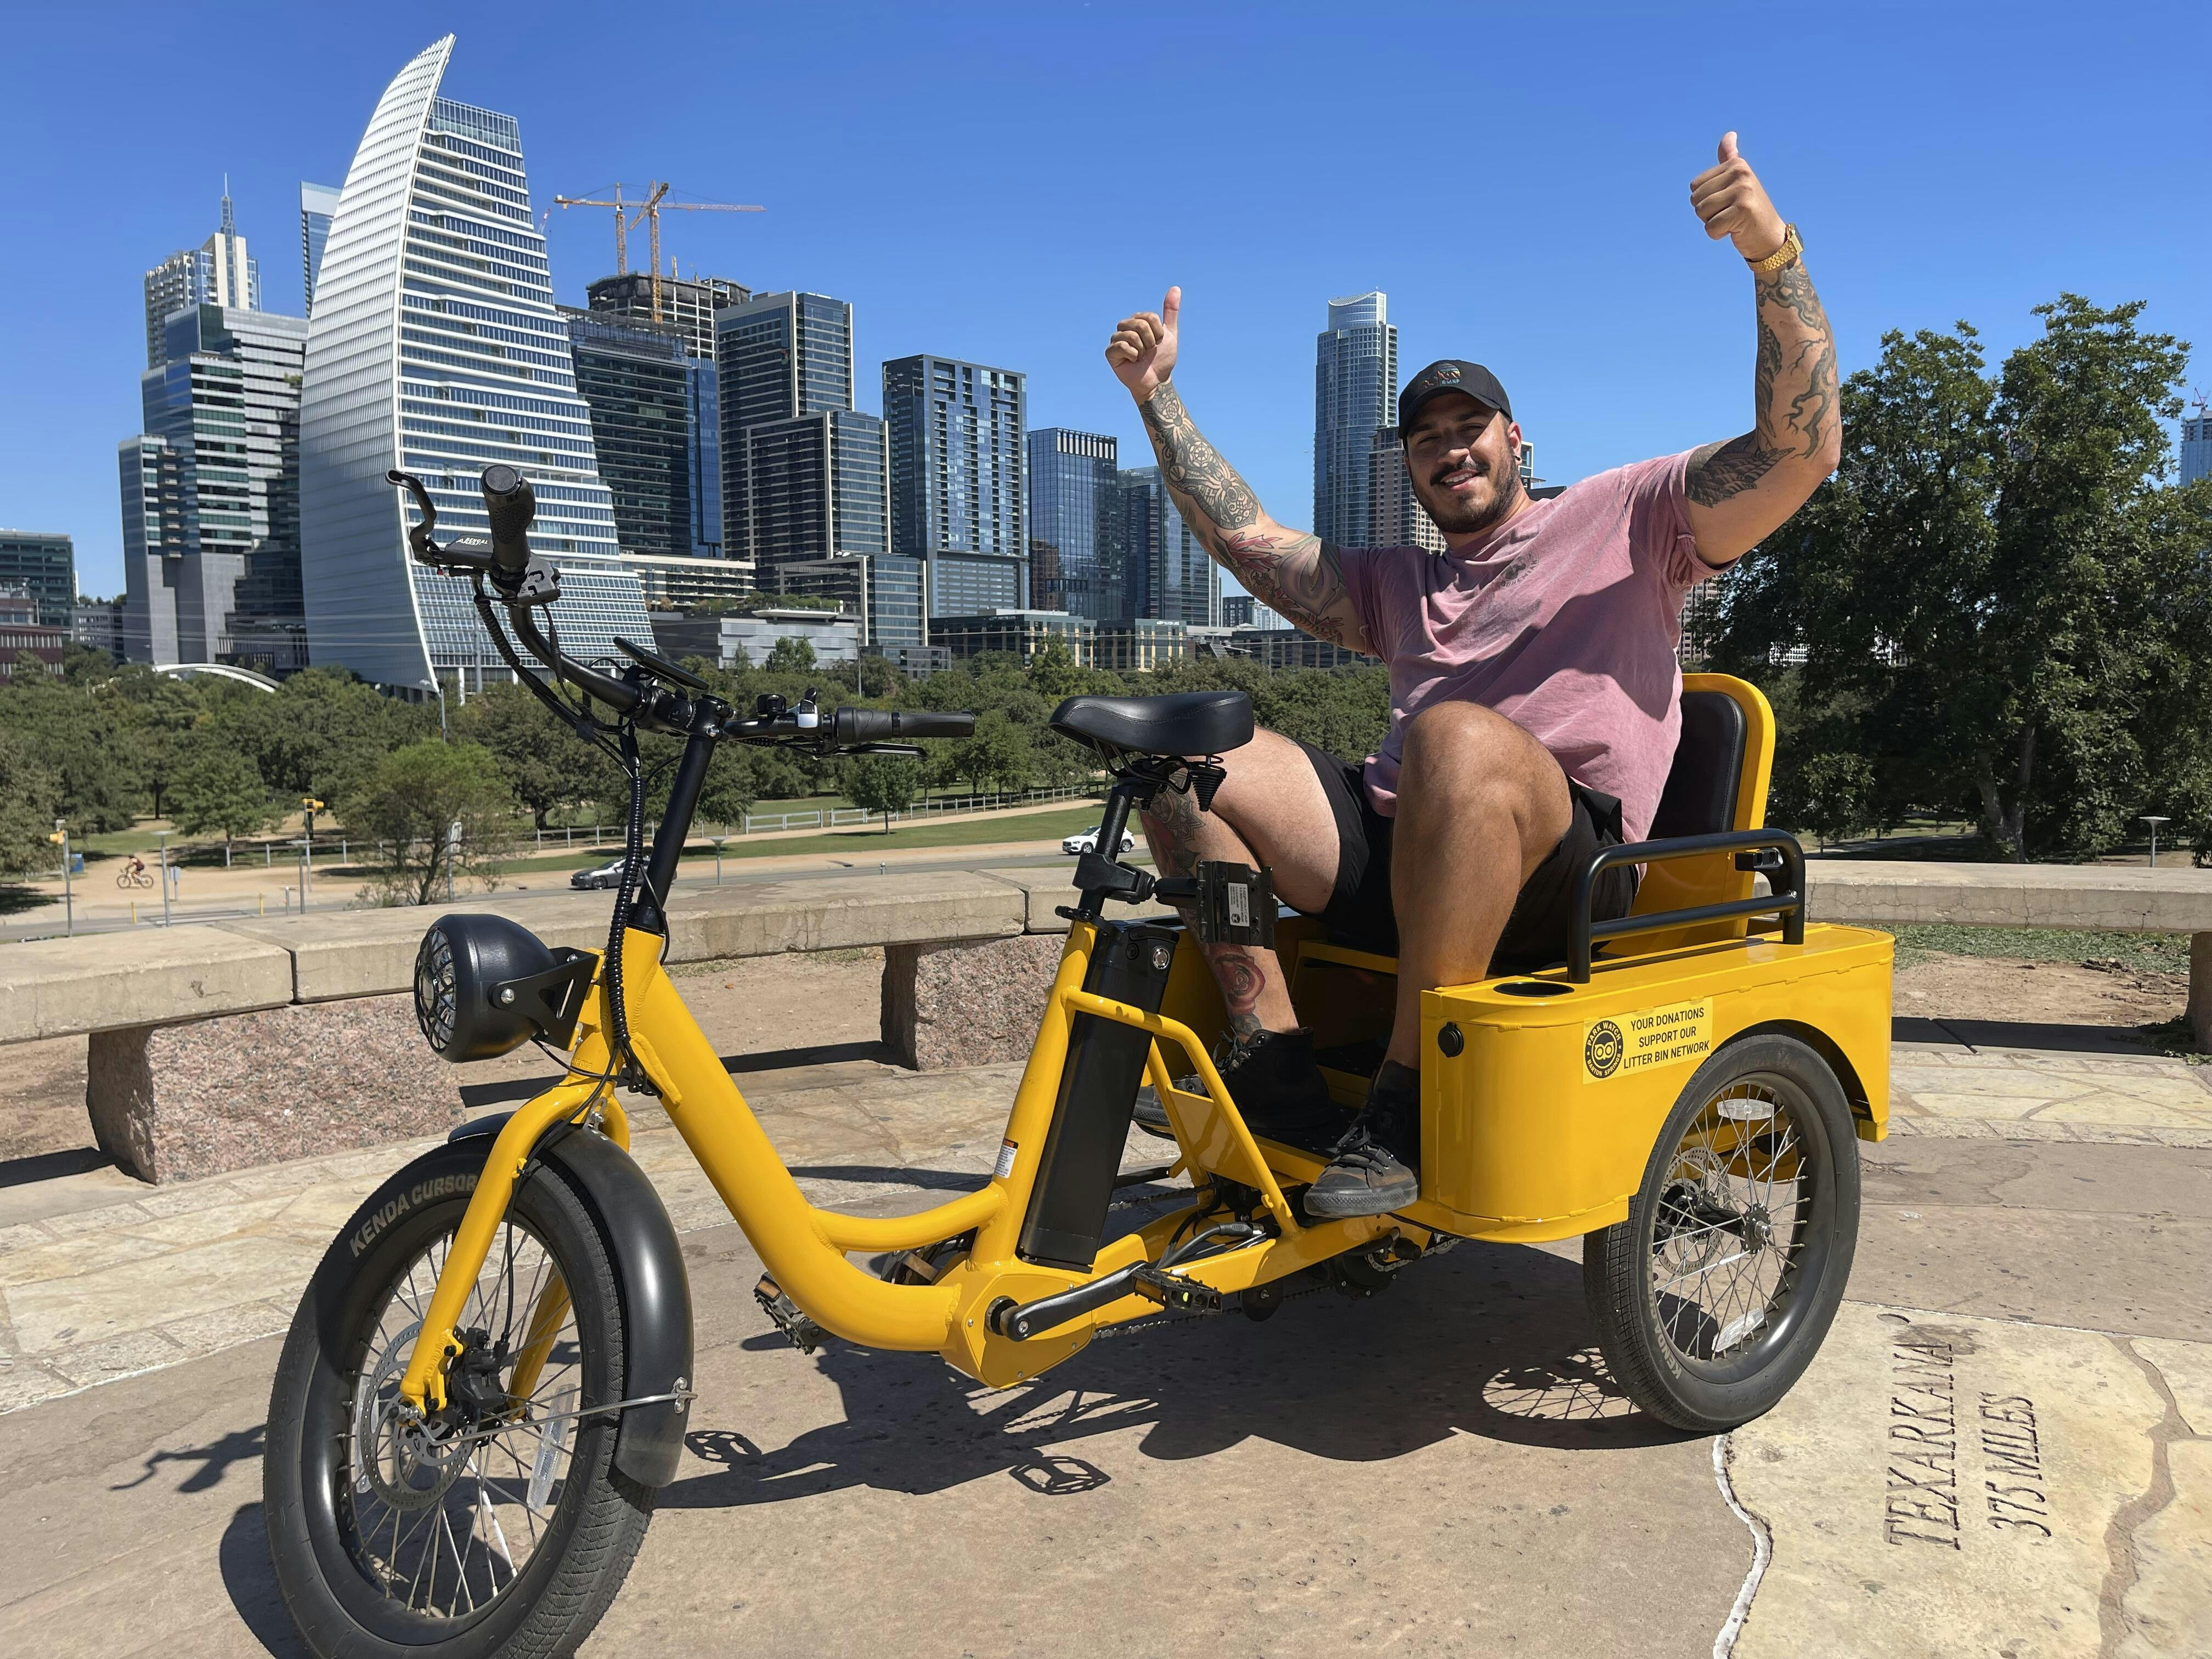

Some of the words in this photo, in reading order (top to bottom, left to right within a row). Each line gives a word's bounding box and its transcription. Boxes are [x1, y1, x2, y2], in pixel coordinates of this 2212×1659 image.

[1587, 1024, 1601, 1046] PARK
[1602, 1022, 1622, 1041] WATCH
[1631, 1017, 1654, 1031] YOUR
[1656, 1007, 1704, 1026] DONATIONS
[1639, 1030, 1678, 1047] SUPPORT
[1680, 1026, 1696, 1039] OUR
[1587, 1059, 1602, 1076] BARTON
[1604, 1053, 1621, 1075] SPRINGS
[1624, 1053, 1652, 1069] LITTER
[1655, 1049, 1668, 1062] BIN
[1671, 1040, 1709, 1058] NETWORK
[349, 1193, 410, 1257] KENDA
[411, 1173, 478, 1205] CURSOR
[1654, 1322, 1682, 1379] KENDA
[1883, 1343, 1961, 1551] TEXARKANA
[1977, 1391, 2044, 1481] MILES
[1985, 1481, 2052, 1537] 375
